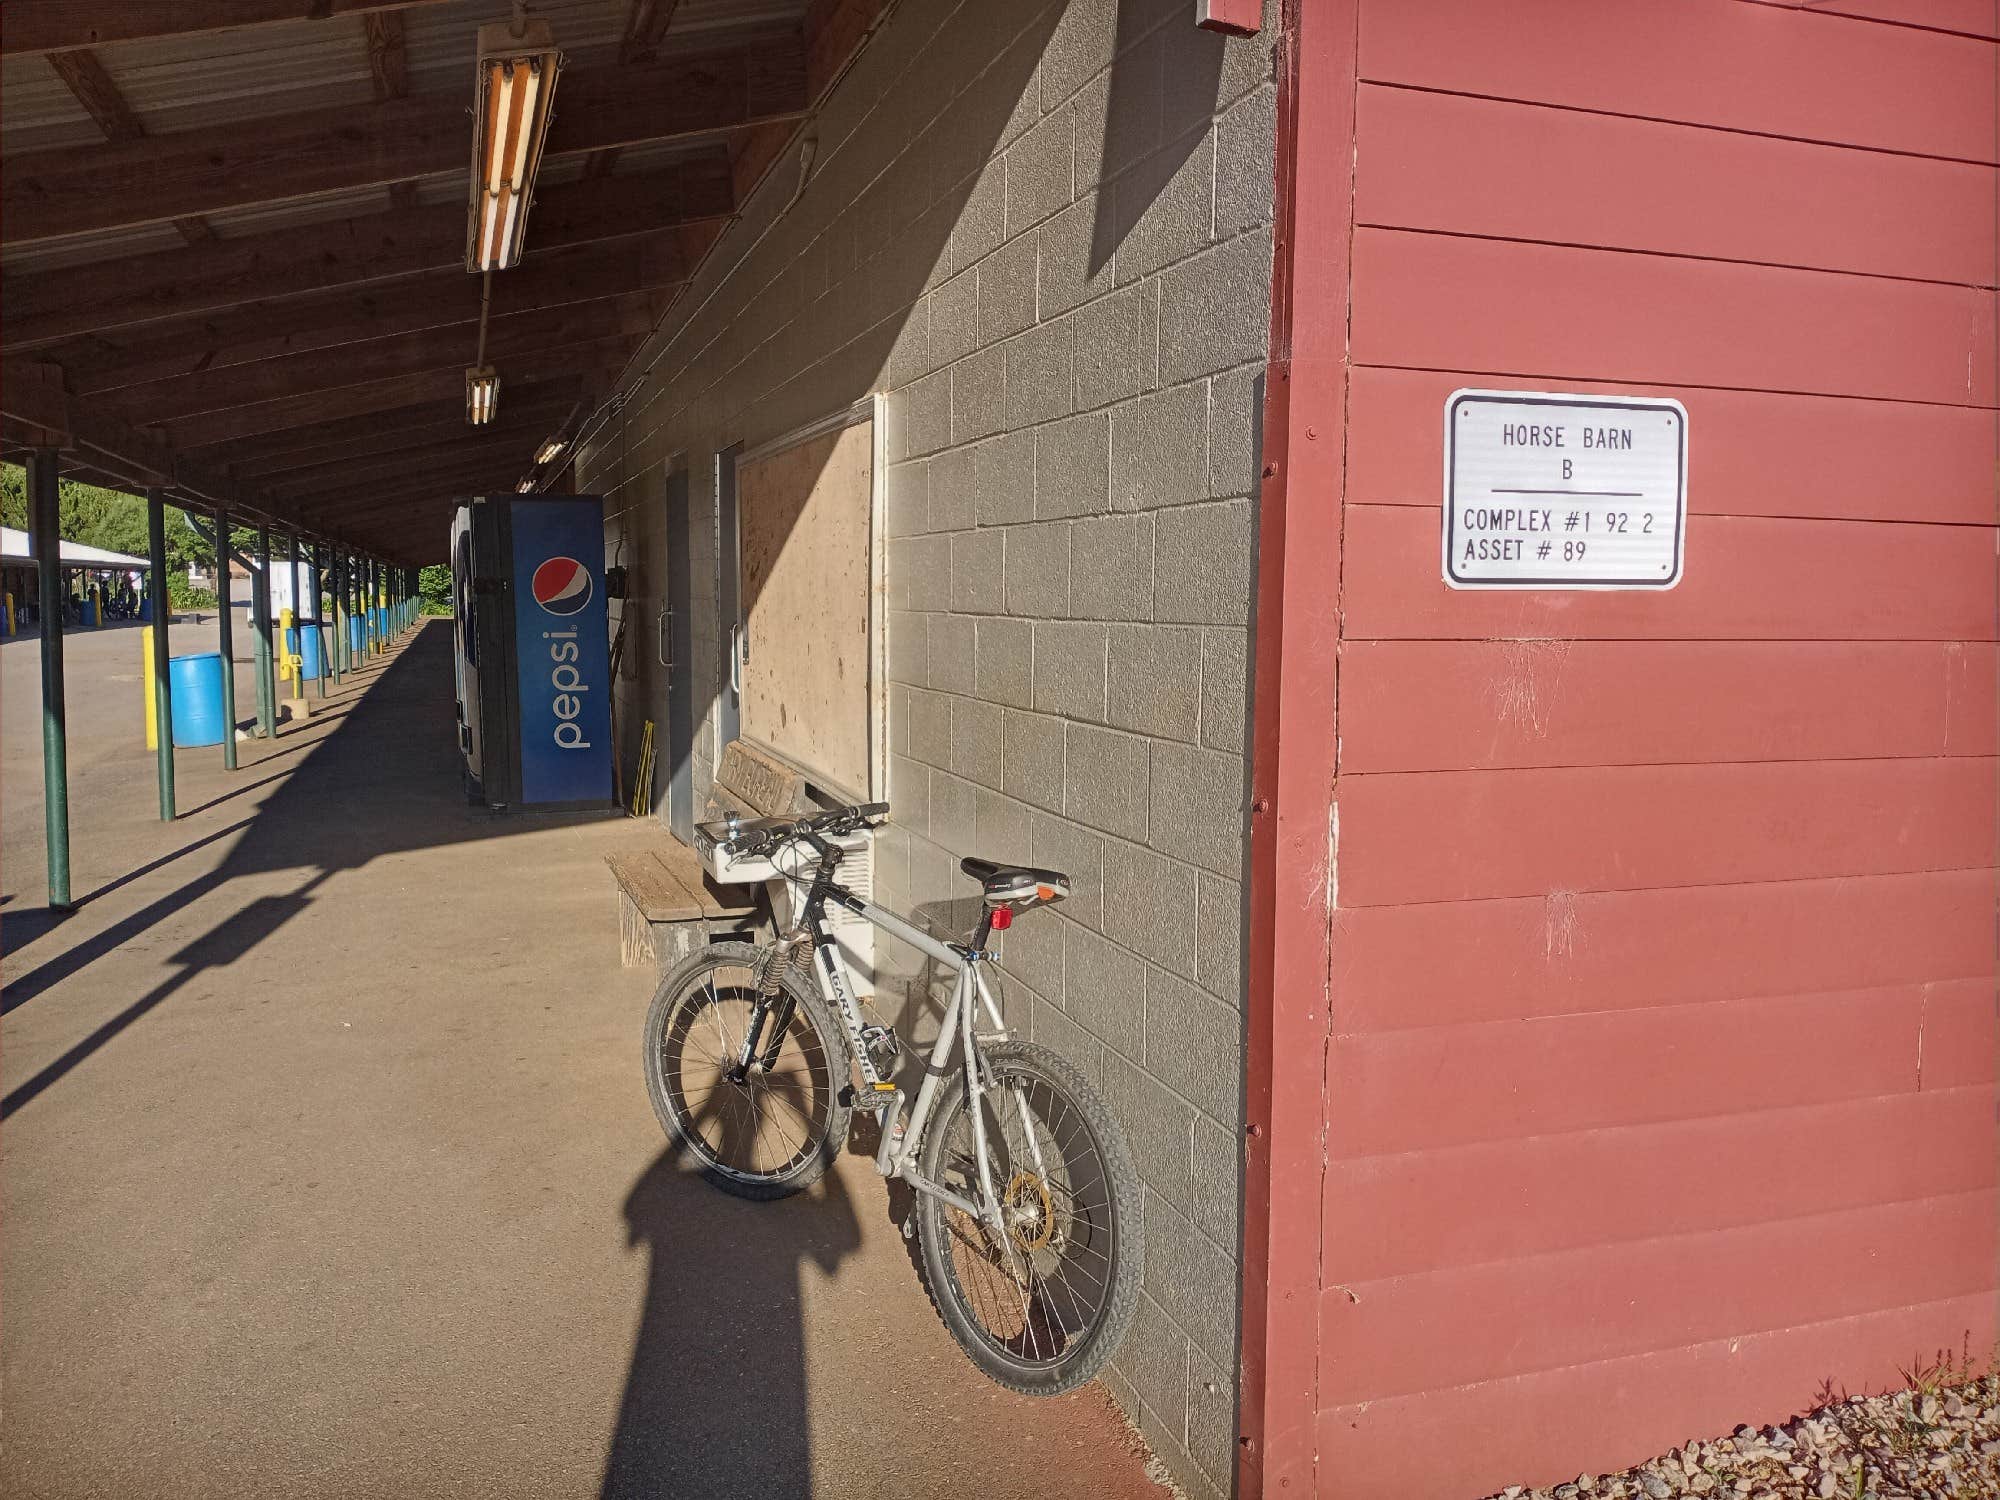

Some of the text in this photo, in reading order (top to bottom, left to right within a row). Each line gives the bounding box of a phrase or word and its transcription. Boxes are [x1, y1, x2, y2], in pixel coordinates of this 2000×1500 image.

[1503, 423, 1633, 450] HORSE BARN
[1562, 458, 1574, 480] B
[1463, 507, 1654, 534] COMPLEX #1 92 2
[1463, 537, 1587, 562] ASSET # 89
[542, 631, 591, 749] pepsi
[831, 974, 876, 1084] GARY FISHE
